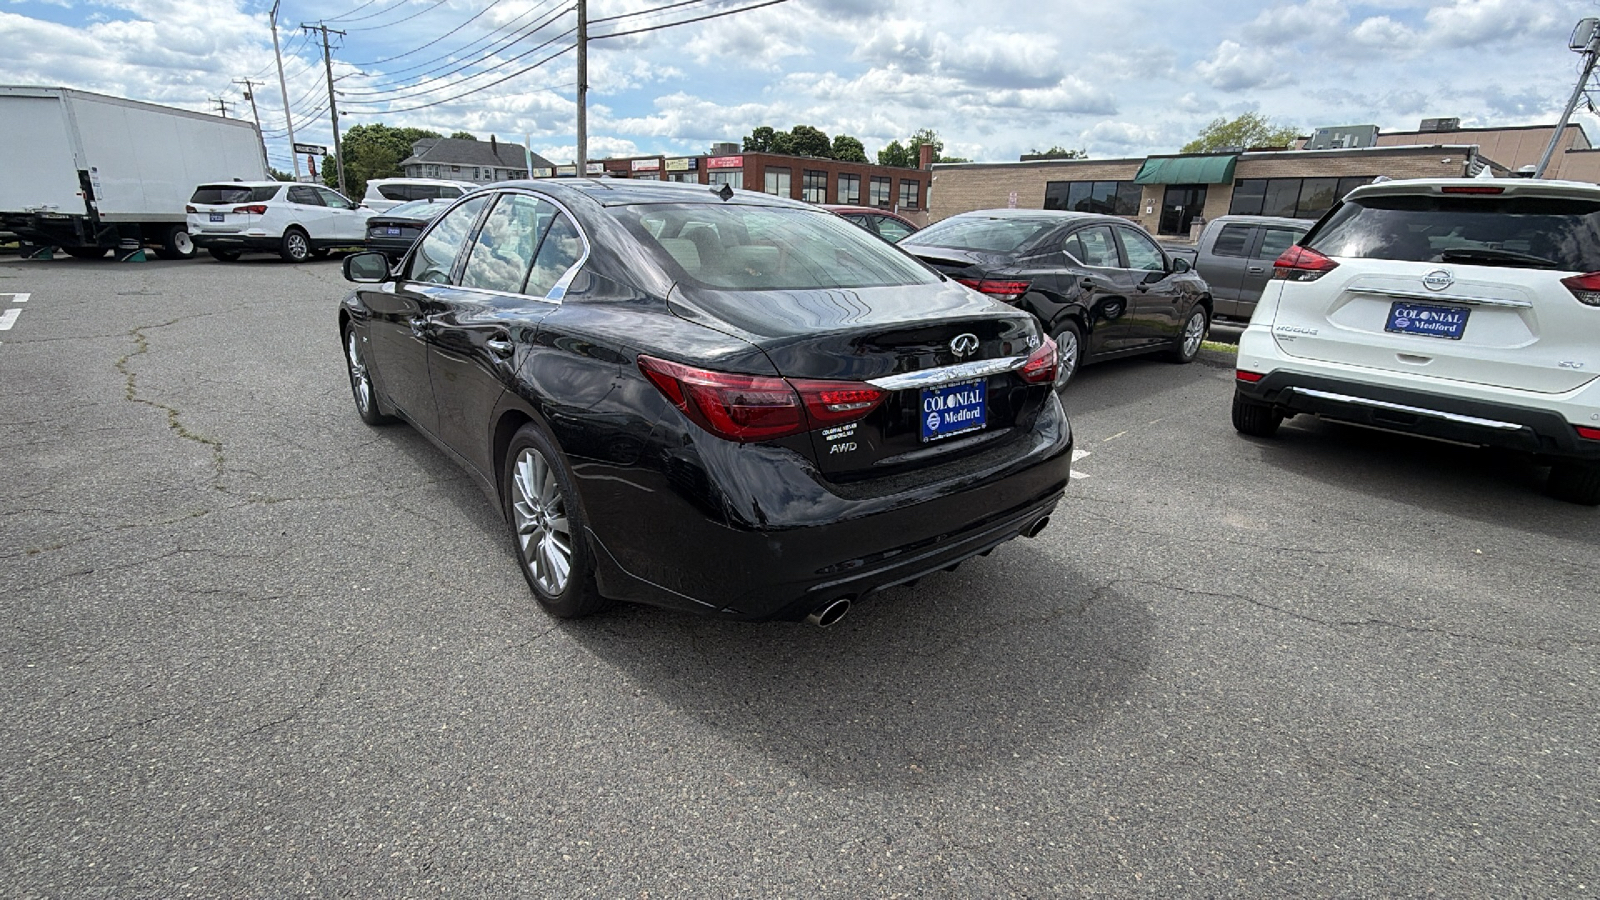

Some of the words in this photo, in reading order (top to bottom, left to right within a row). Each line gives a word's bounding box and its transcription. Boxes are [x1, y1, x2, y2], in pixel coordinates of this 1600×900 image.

[1395, 308, 1462, 324] COLONIAL
[1413, 321, 1457, 332] Medford
[924, 389, 983, 413] COLONIAL
[944, 406, 981, 424] Medford
[829, 442, 858, 454] AWD
